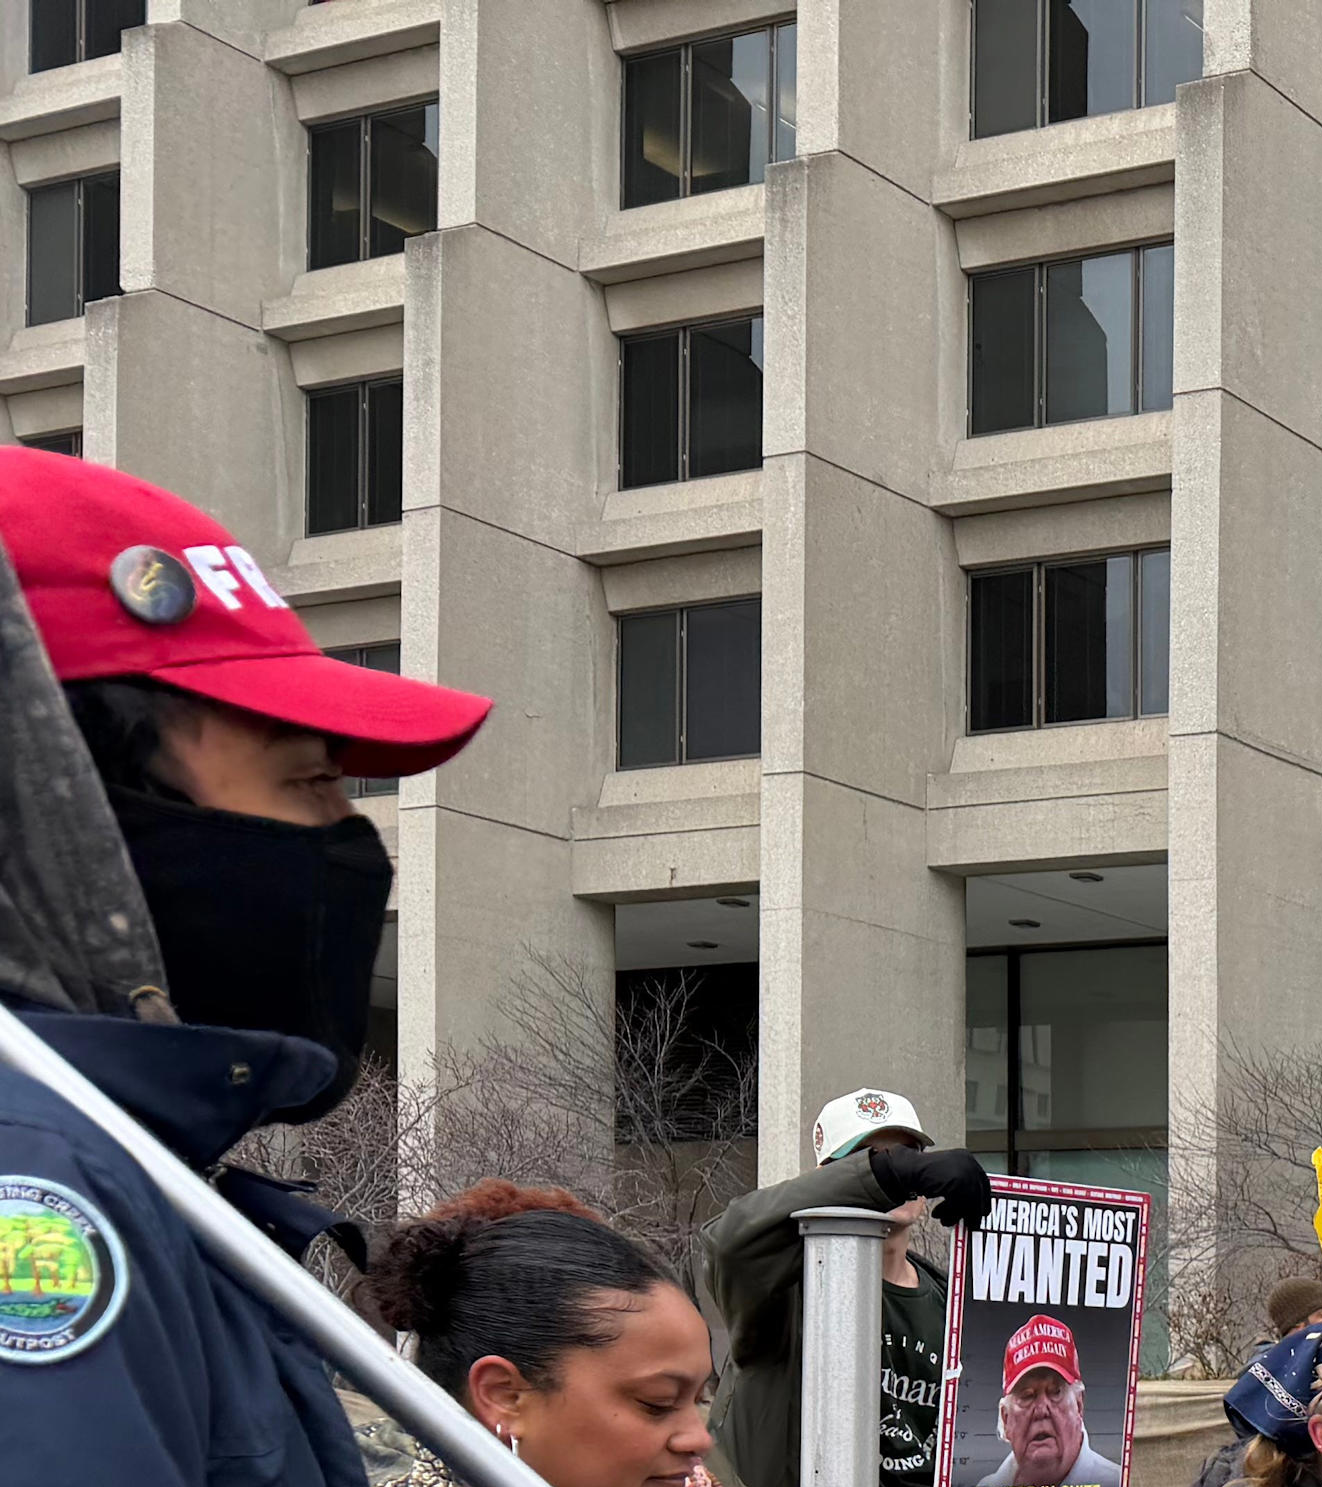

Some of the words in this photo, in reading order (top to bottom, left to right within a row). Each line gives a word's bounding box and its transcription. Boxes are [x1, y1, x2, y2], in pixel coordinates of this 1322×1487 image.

[1083, 1207, 1136, 1243] MOST
[971, 1231, 1133, 1308] WANTED
[0, 1328, 75, 1350] UTPOST
[1033, 1324, 1070, 1343] AMERICA
[884, 1334, 938, 1365] EING
[1041, 1342, 1067, 1358] AGAIN
[882, 1454, 925, 1471] OING
